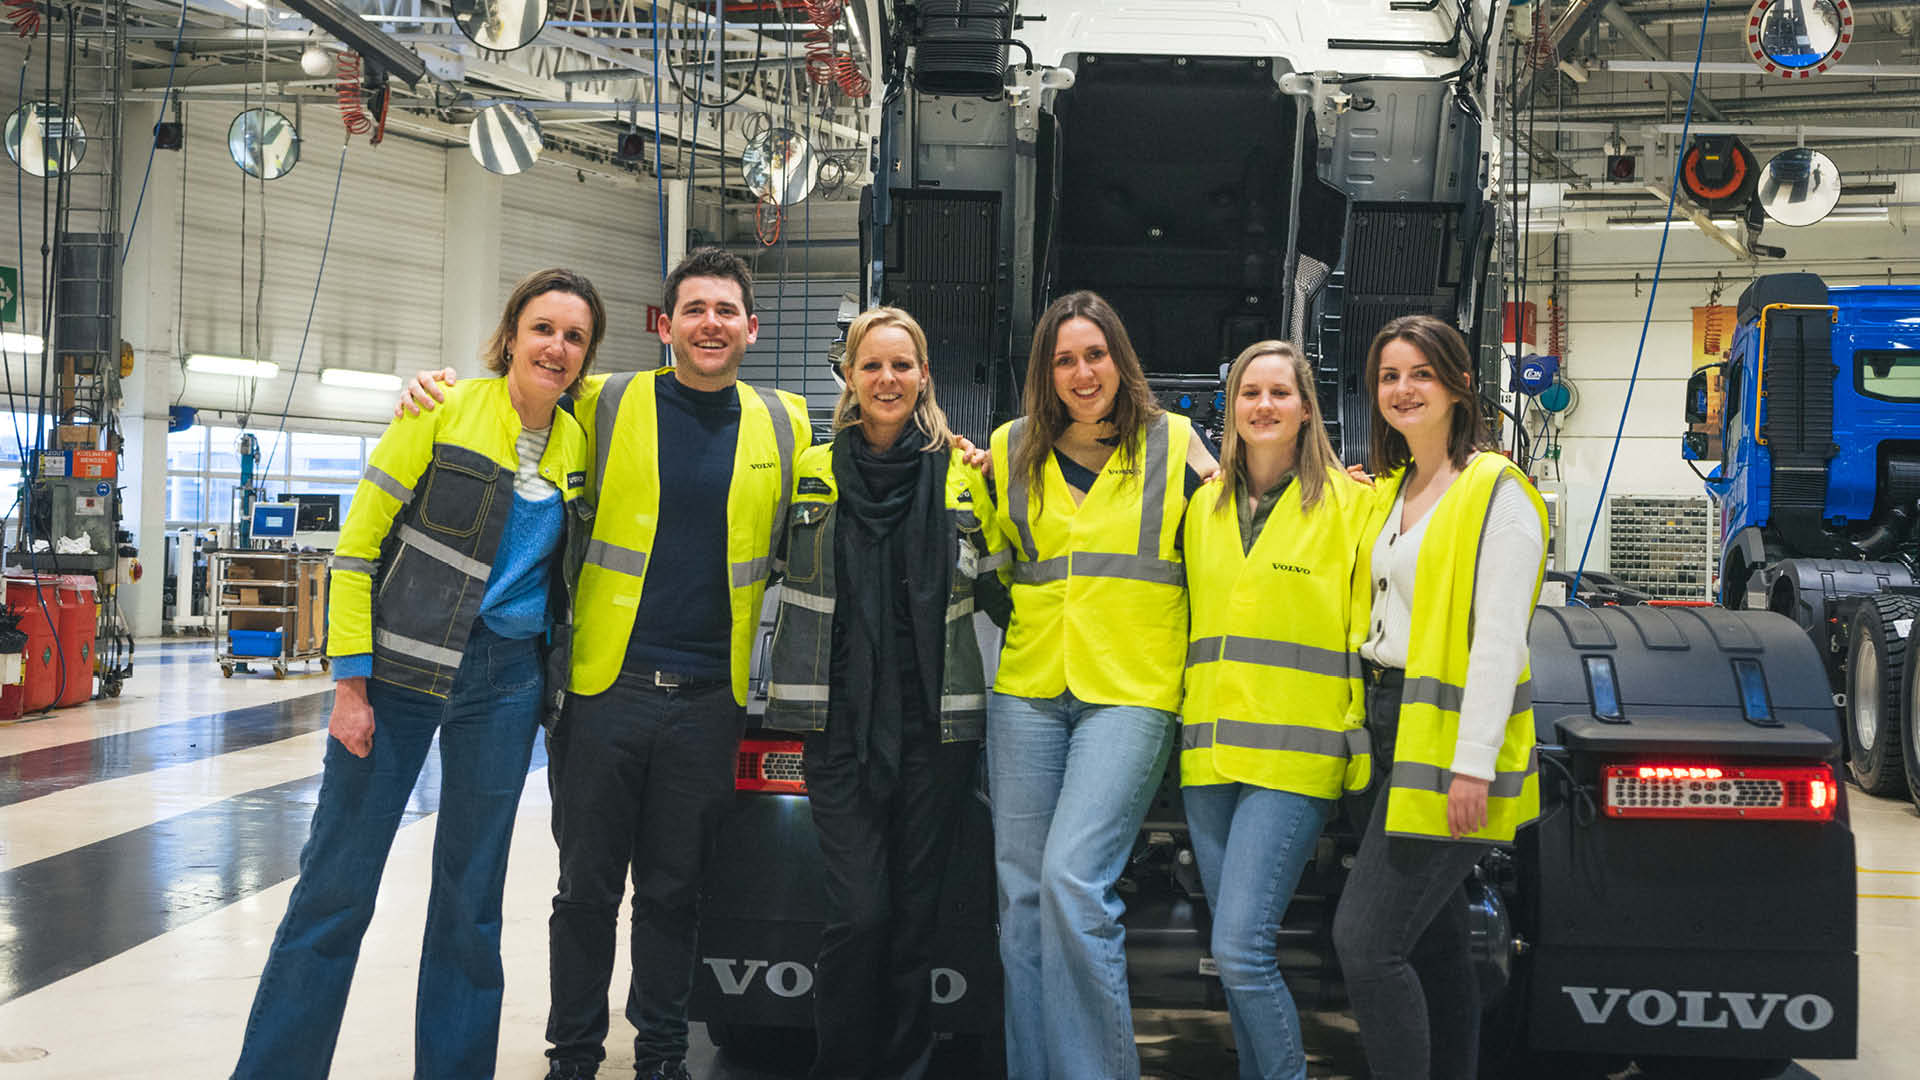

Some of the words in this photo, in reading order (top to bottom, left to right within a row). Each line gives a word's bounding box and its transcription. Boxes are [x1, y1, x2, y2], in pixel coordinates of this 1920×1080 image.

[1271, 562, 1311, 575] VOLVO
[703, 957, 968, 1004] VOO
[1561, 986, 1834, 1031] VOLVO
